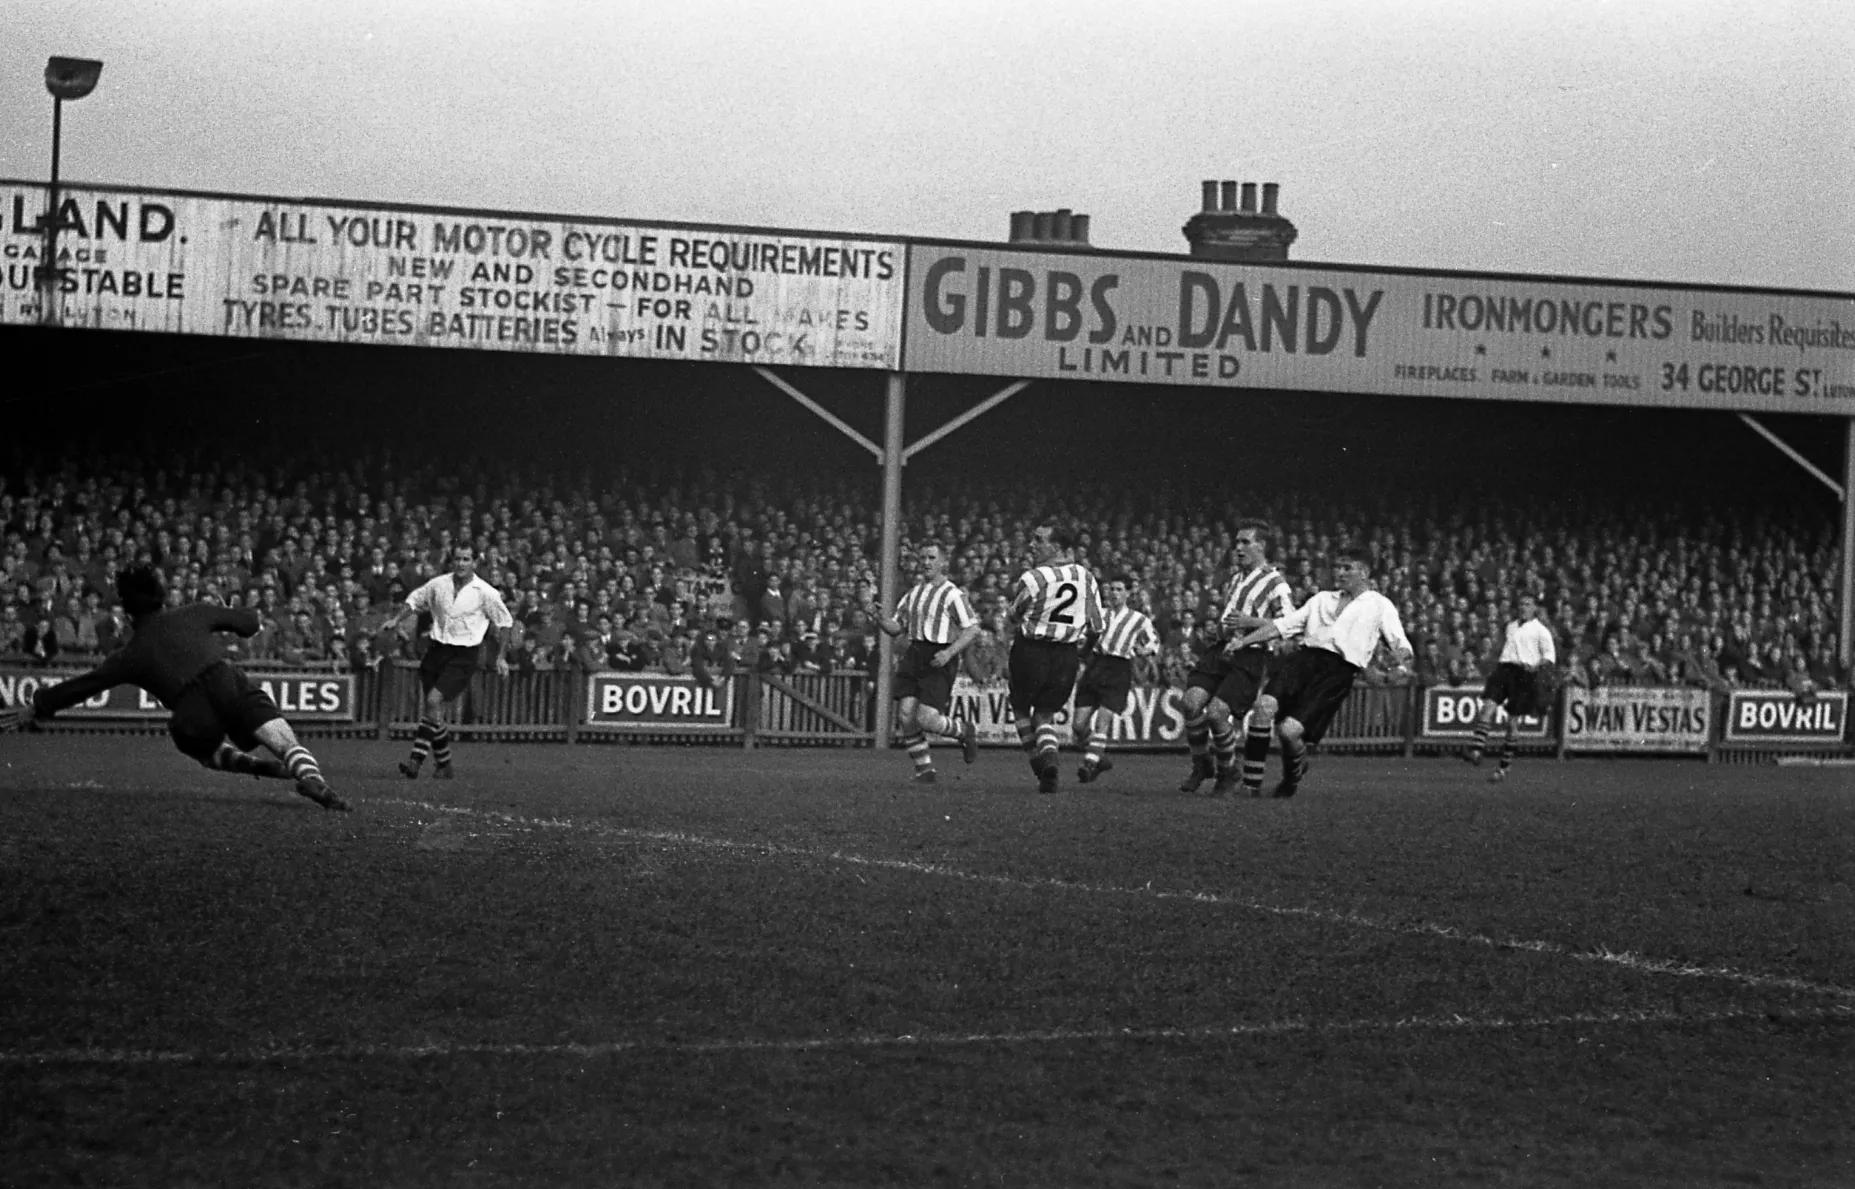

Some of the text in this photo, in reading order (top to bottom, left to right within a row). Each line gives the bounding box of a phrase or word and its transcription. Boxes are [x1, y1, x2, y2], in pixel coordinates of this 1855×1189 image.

[0, 194, 188, 244] LAND.
[4, 245, 107, 263] GAAGE
[255, 211, 894, 280] ALL YOUR MOTOR CYCLE REQUIREMENTS
[0, 265, 185, 299] USTABLE
[388, 256, 754, 298] NEW AND SECONDHAND
[253, 274, 349, 299] SPARE
[367, 281, 445, 304] PART
[460, 286, 595, 313] STOCKIST
[638, 297, 691, 320] FOR
[707, 302, 758, 325] ALL
[773, 308, 869, 331] AES
[922, 256, 1385, 359] GIBBS AND DANDY
[1422, 292, 1674, 341] IRONMONGERS
[325, 305, 412, 335] TUBES
[430, 311, 577, 344] BATTERIES
[655, 324, 685, 351] IN
[701, 329, 812, 356] STOCK
[1691, 309, 1765, 344] Builders
[1059, 347, 1241, 380] LIMITED
[1394, 364, 1478, 383] FIREPLACES
[1661, 362, 1690, 391] 34
[1698, 363, 1786, 396] GEORGE
[1048, 583, 1079, 625] 2
[601, 684, 722, 716] BOVRIL
[1090, 686, 1185, 740] RYS
[1569, 700, 1706, 735] SWAN VESTAS
[1740, 701, 1837, 731] BOVRIL
